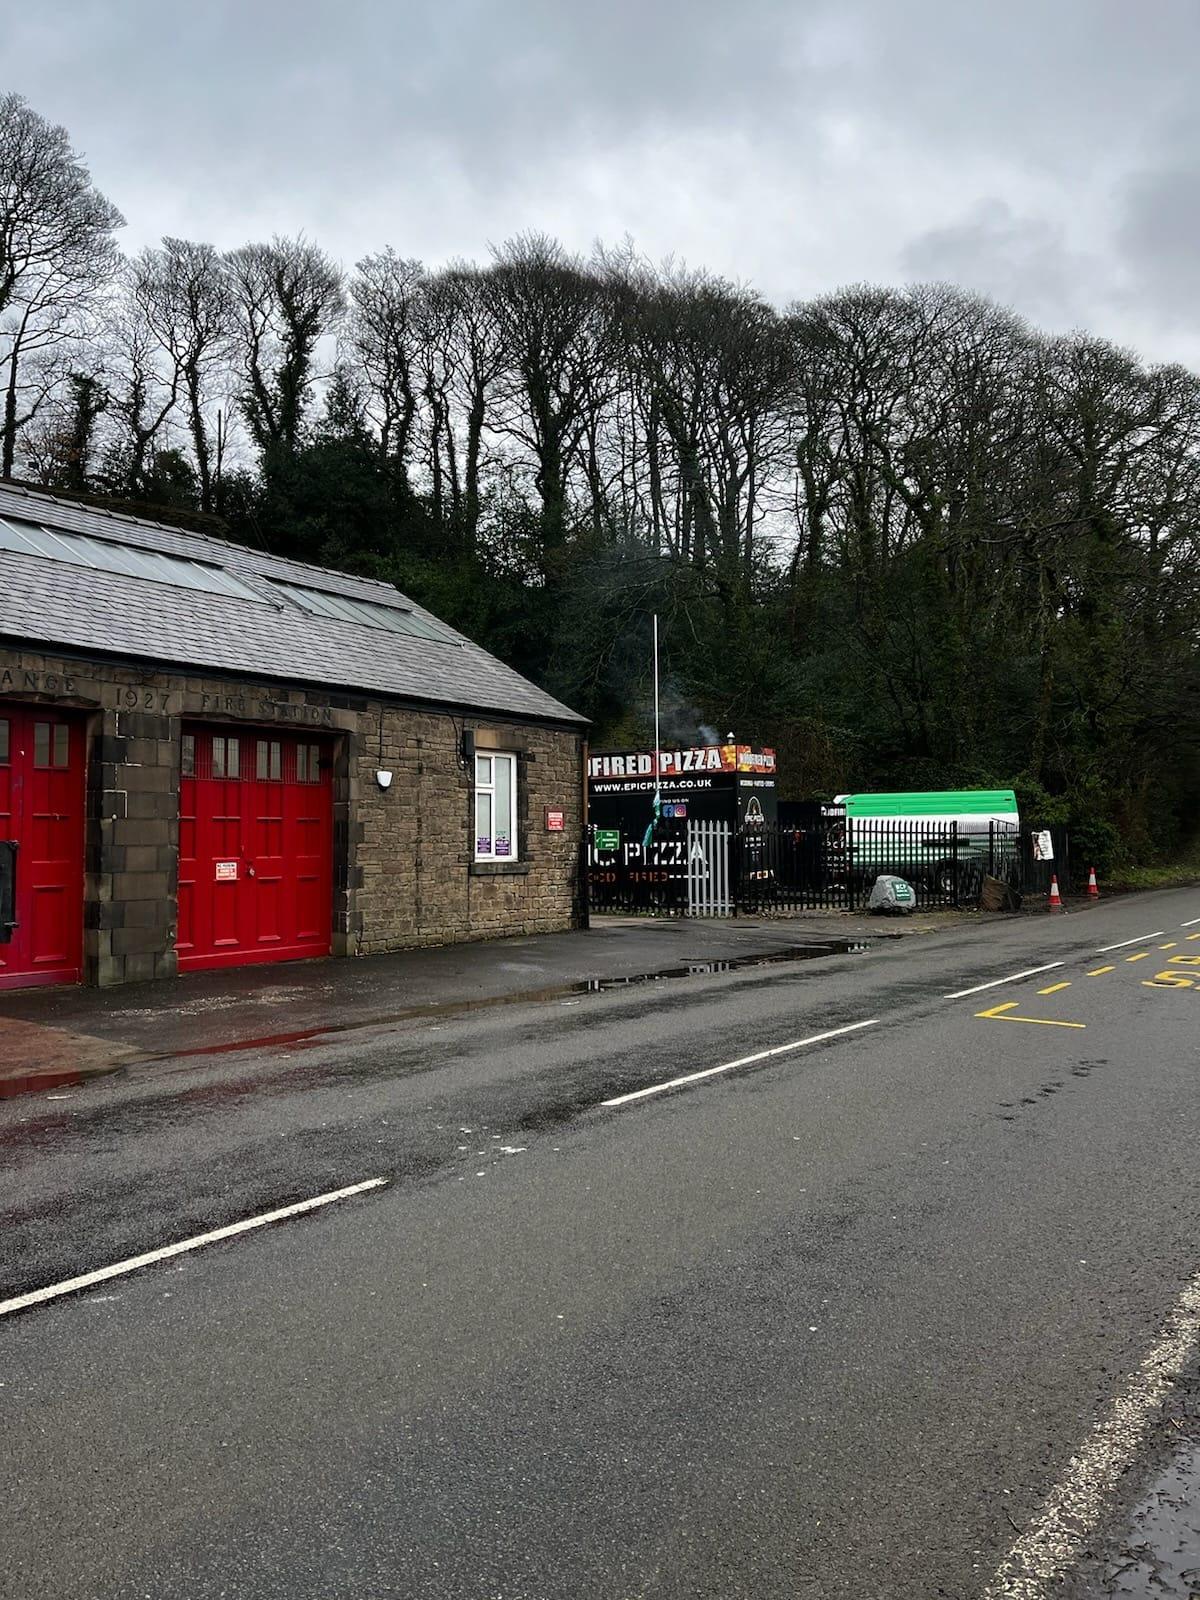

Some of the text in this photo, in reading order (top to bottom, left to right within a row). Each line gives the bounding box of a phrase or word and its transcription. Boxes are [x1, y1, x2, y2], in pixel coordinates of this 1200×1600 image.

[115, 687, 170, 711] 1927
[202, 694, 246, 713] FIRE
[661, 749, 722, 772] PIZZA
[594, 779, 712, 792] WWW.EPICPIZZA.CO.UK
